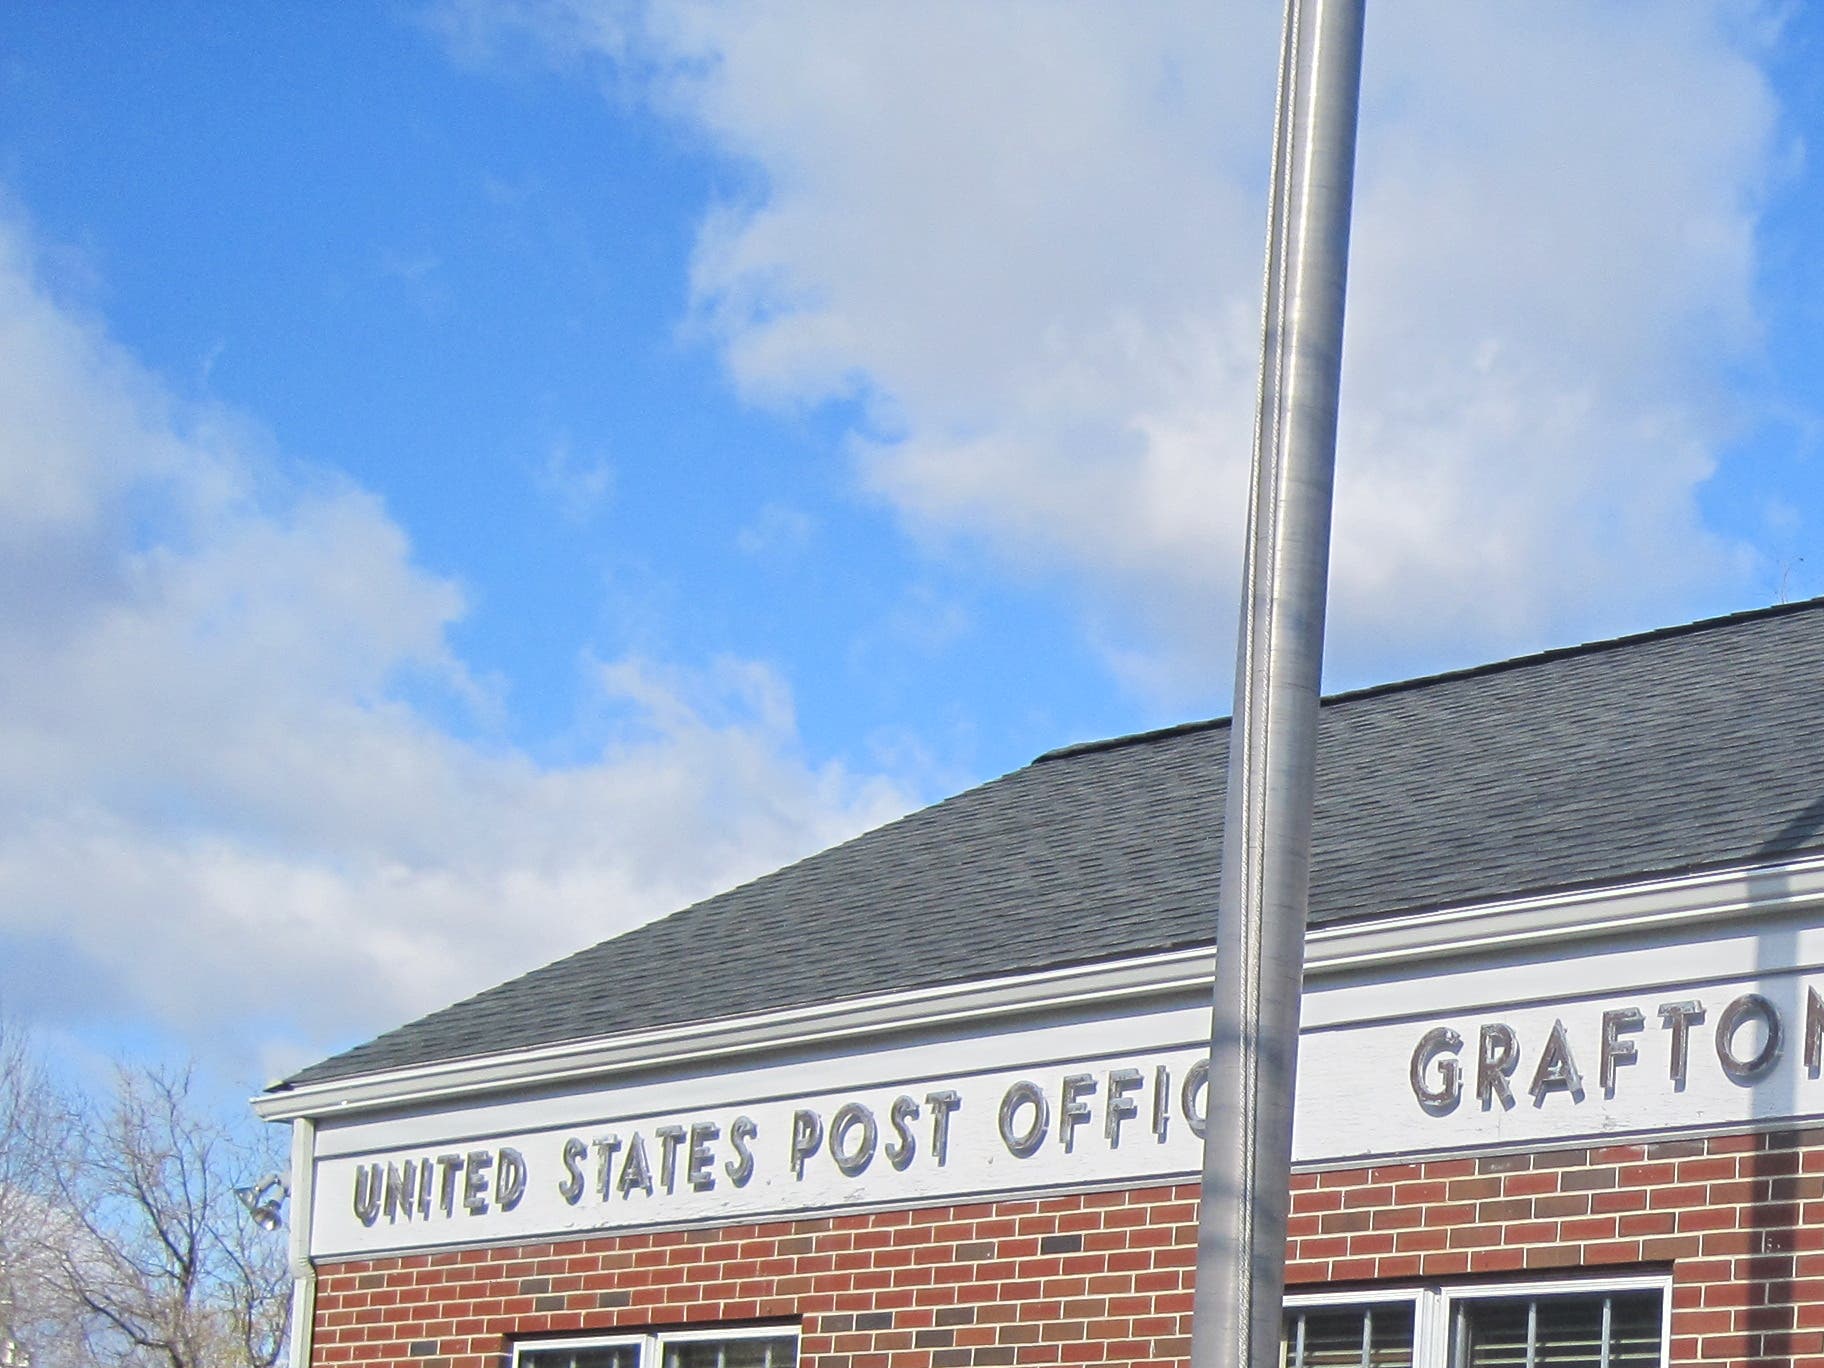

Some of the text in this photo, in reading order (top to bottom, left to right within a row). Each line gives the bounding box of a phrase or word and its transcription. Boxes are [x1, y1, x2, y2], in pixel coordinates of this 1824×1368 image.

[354, 1147, 528, 1227] UNITED
[558, 1115, 758, 1205] STATES
[790, 1089, 962, 1181] POST
[999, 1058, 1209, 1158] OFFIC
